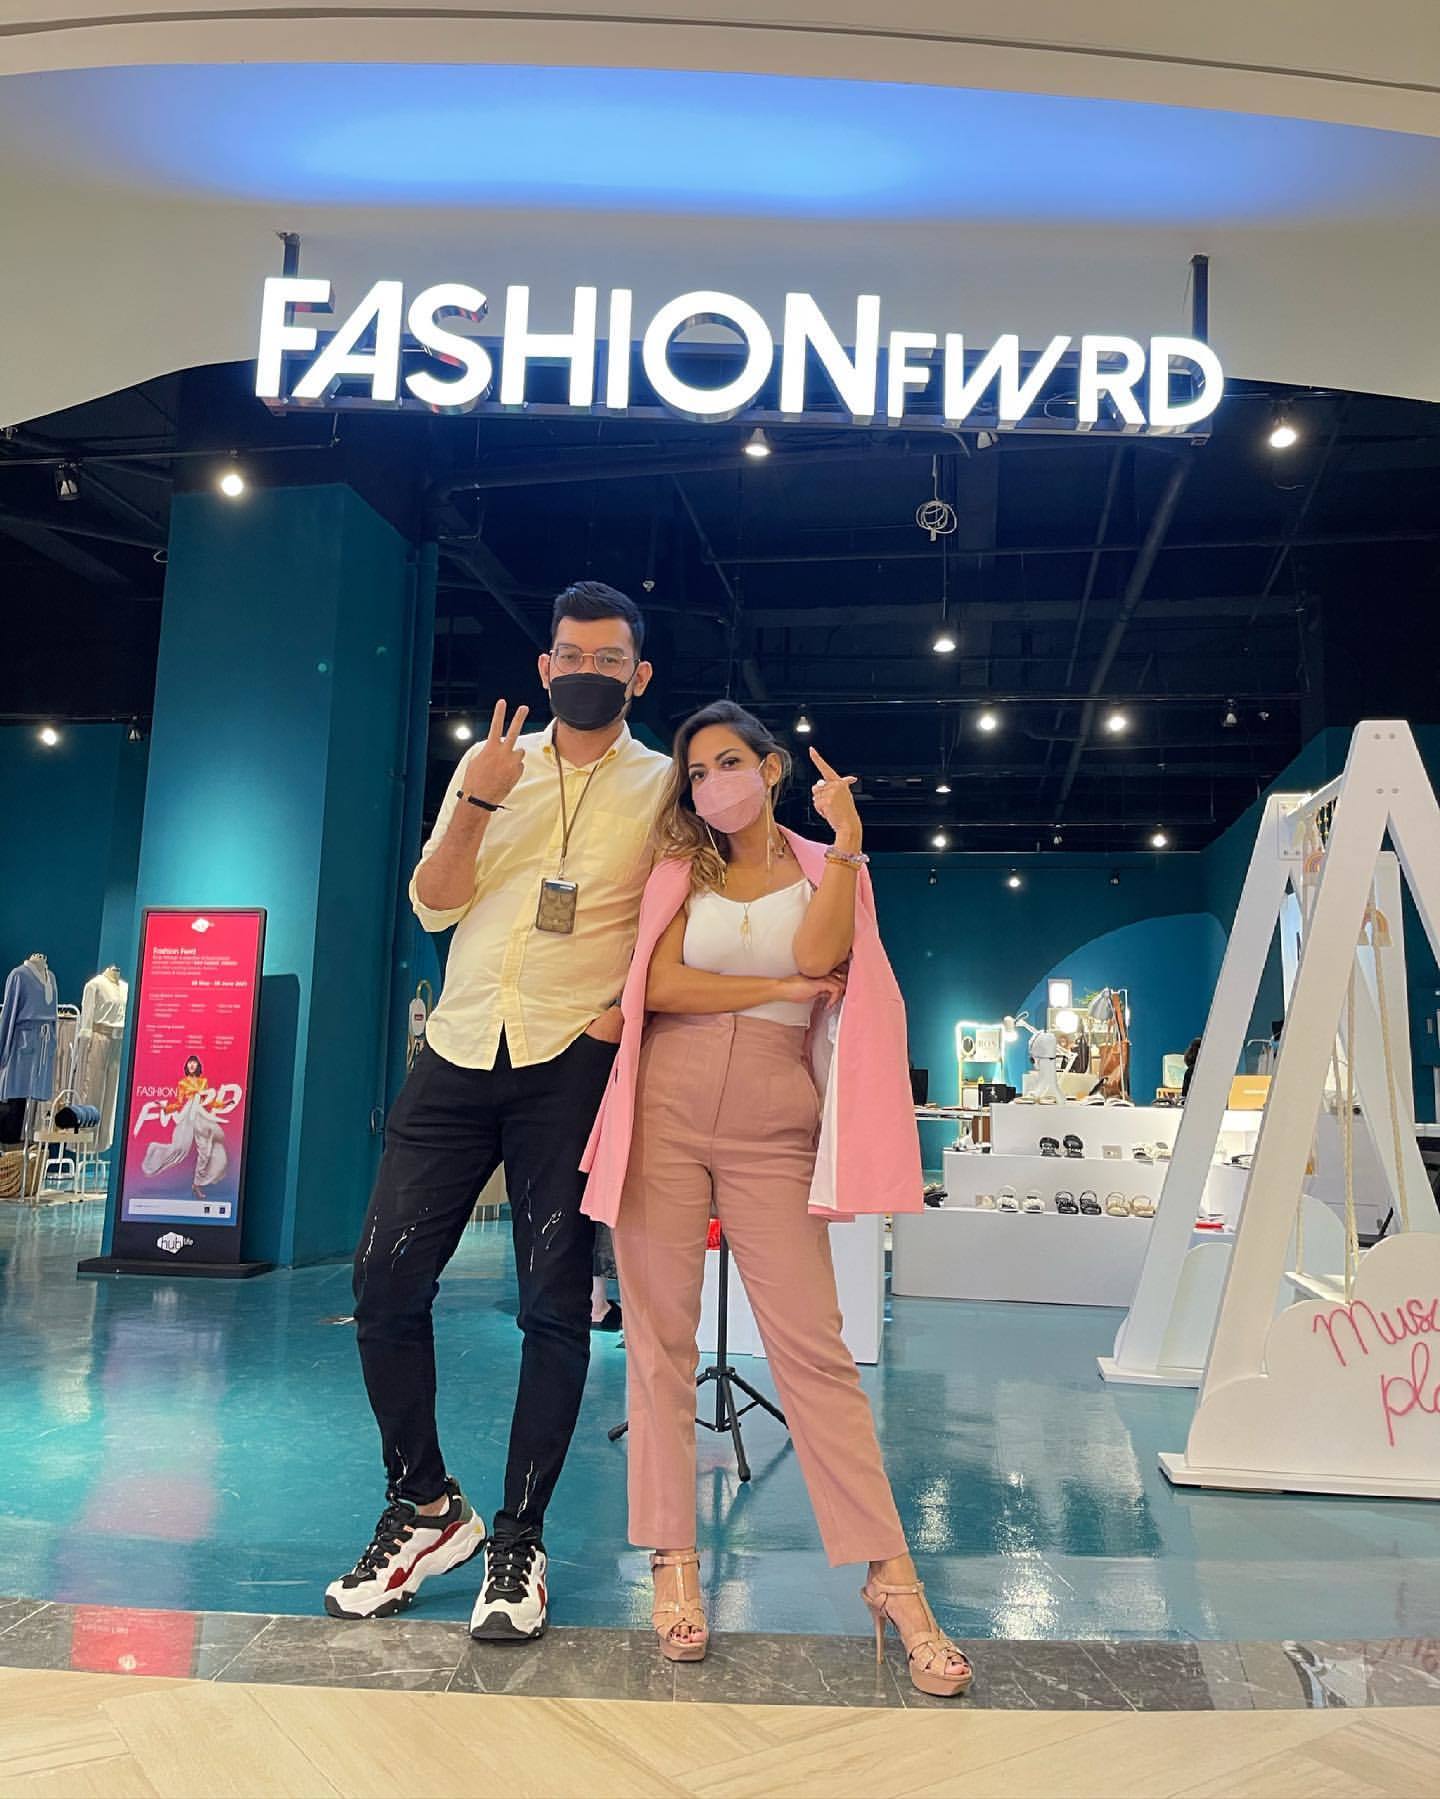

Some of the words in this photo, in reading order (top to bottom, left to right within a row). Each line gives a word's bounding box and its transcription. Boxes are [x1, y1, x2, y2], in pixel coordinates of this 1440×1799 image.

[255, 276, 881, 418] FASHION
[887, 330, 1225, 428] FWRD
[136, 1086, 178, 1097] FASHION
